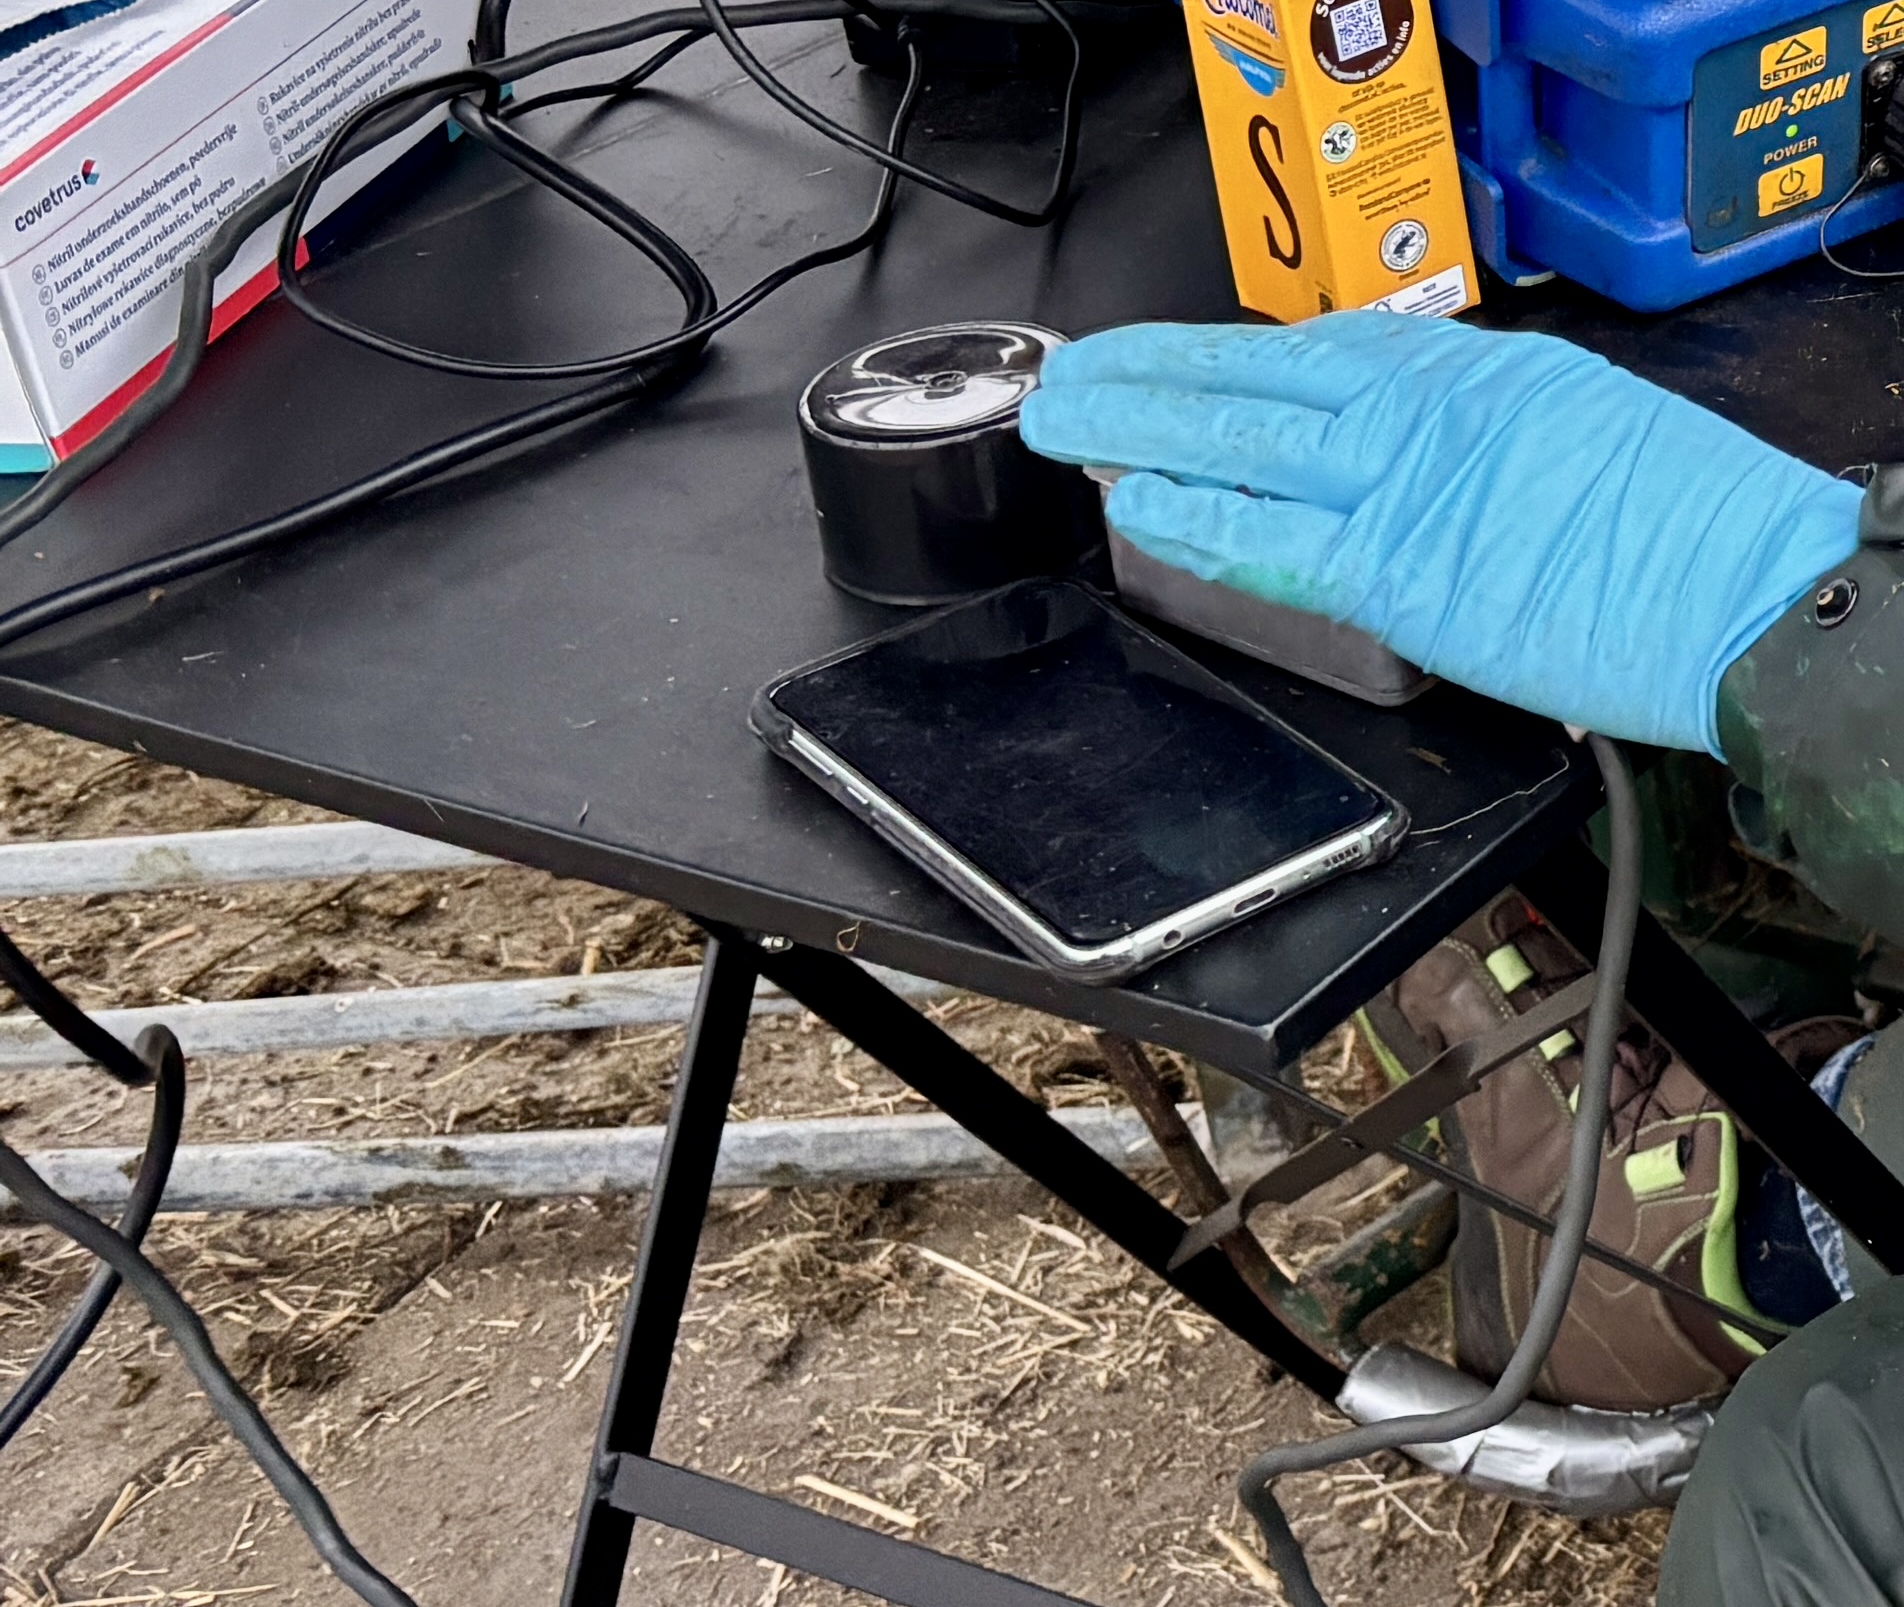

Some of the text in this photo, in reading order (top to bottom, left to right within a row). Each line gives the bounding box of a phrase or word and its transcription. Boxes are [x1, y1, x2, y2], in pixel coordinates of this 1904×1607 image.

[1762, 54, 1826, 86] SETTING
[1733, 71, 1851, 137] DUO-SCAN
[1763, 135, 1818, 166] POWER
[14, 173, 82, 234] covetrus
[1249, 114, 1303, 269] S
[53, 266, 84, 295] Luvas
